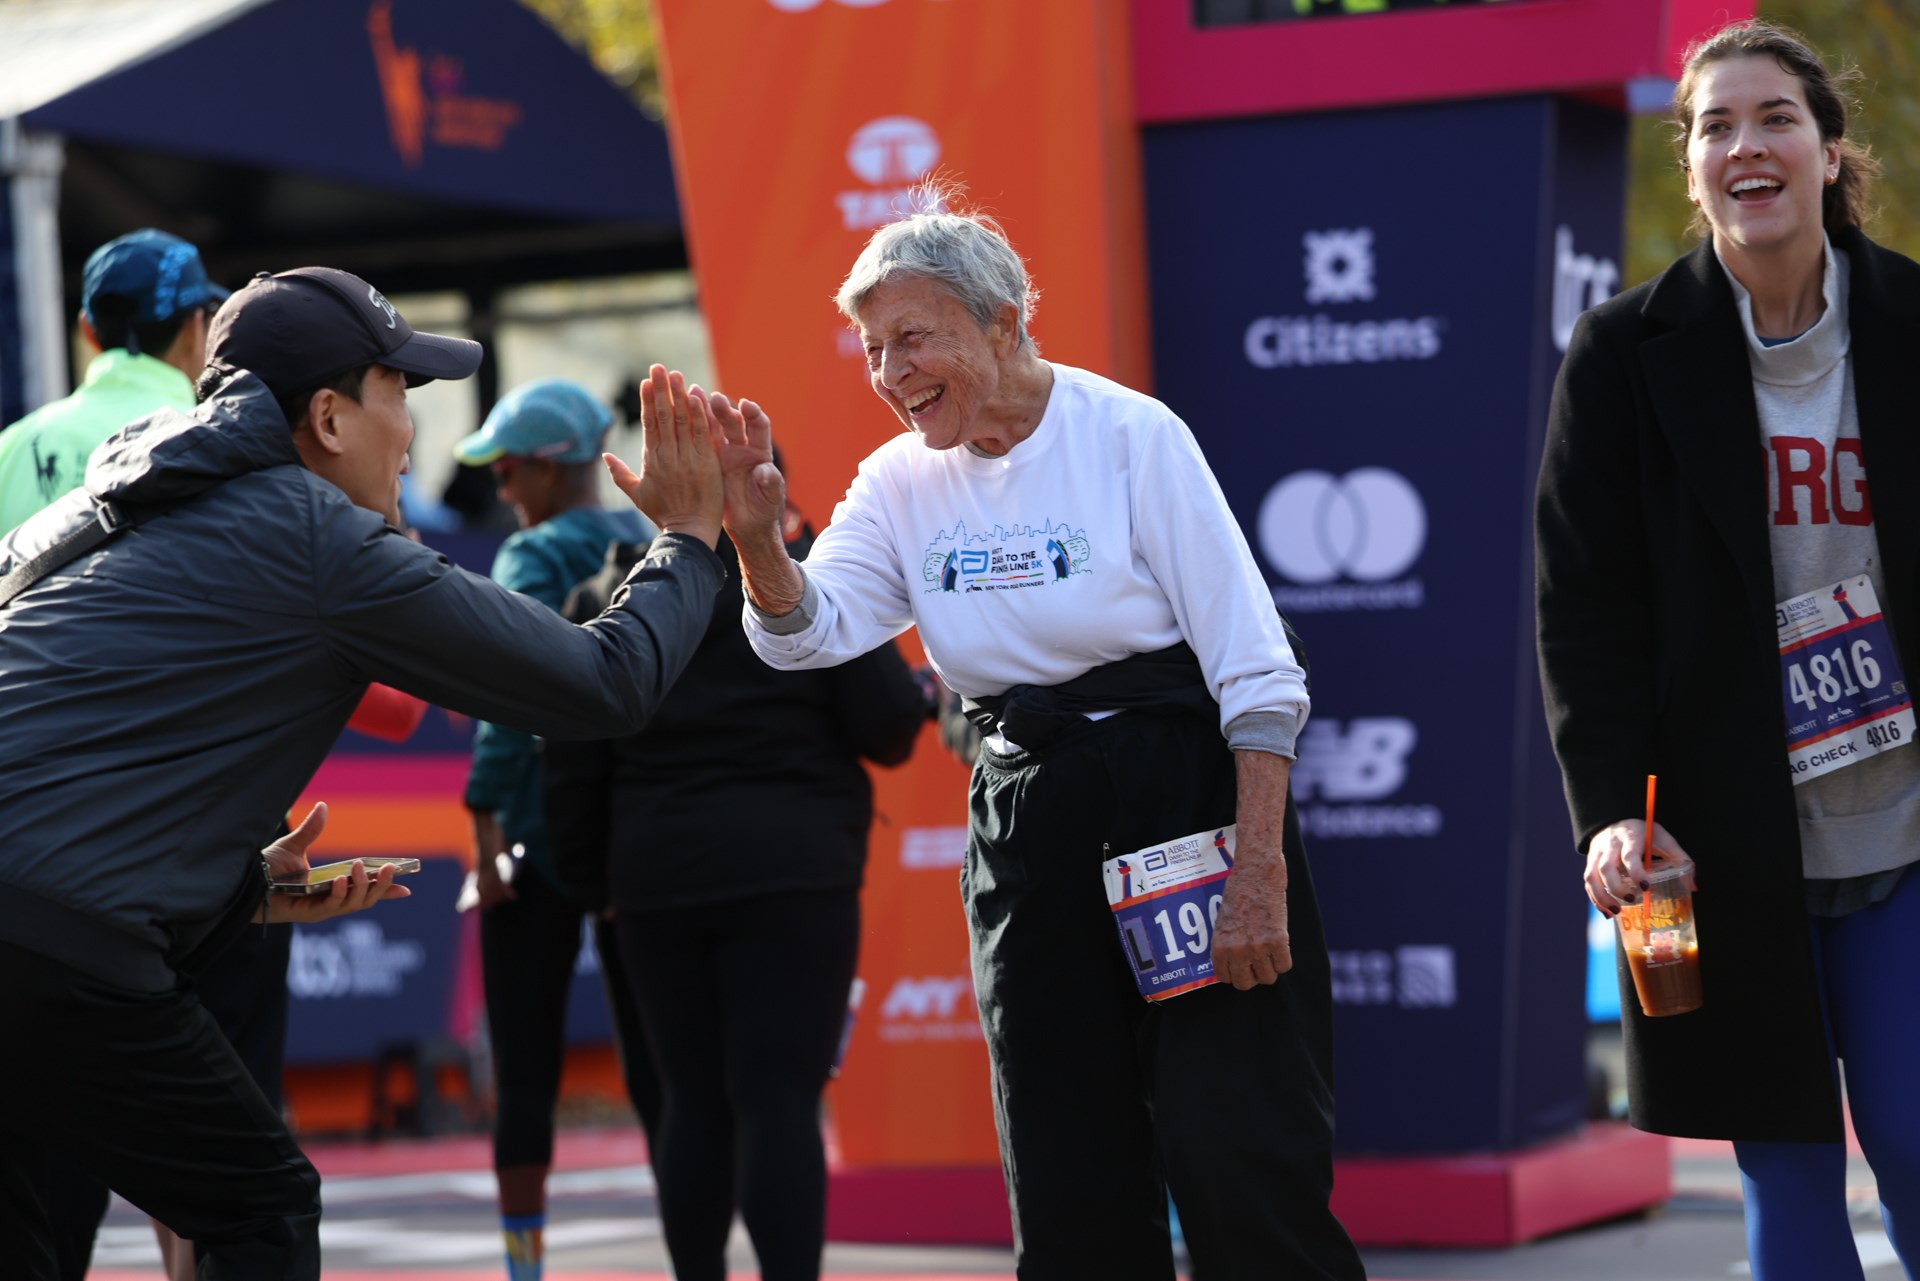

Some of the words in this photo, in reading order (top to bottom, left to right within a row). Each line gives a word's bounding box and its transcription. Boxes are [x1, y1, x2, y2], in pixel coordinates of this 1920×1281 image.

[1245, 314, 1440, 367] Citizens
[1760, 435, 1874, 526] RG
[1005, 554, 1018, 562] TO
[1021, 550, 1036, 561] THE
[1010, 562, 1029, 571] LINE
[1031, 560, 1043, 569] 5K
[1787, 596, 1816, 613] ABBOTT
[1788, 639, 1881, 711] 4816
[1789, 719, 1817, 736] ABBOTT
[1789, 760, 1808, 774] AG
[1810, 742, 1858, 767] CHECK
[1866, 720, 1901, 748] 4816
[1168, 839, 1200, 855] ABBOTT
[1160, 967, 1186, 983] ABBOTT
